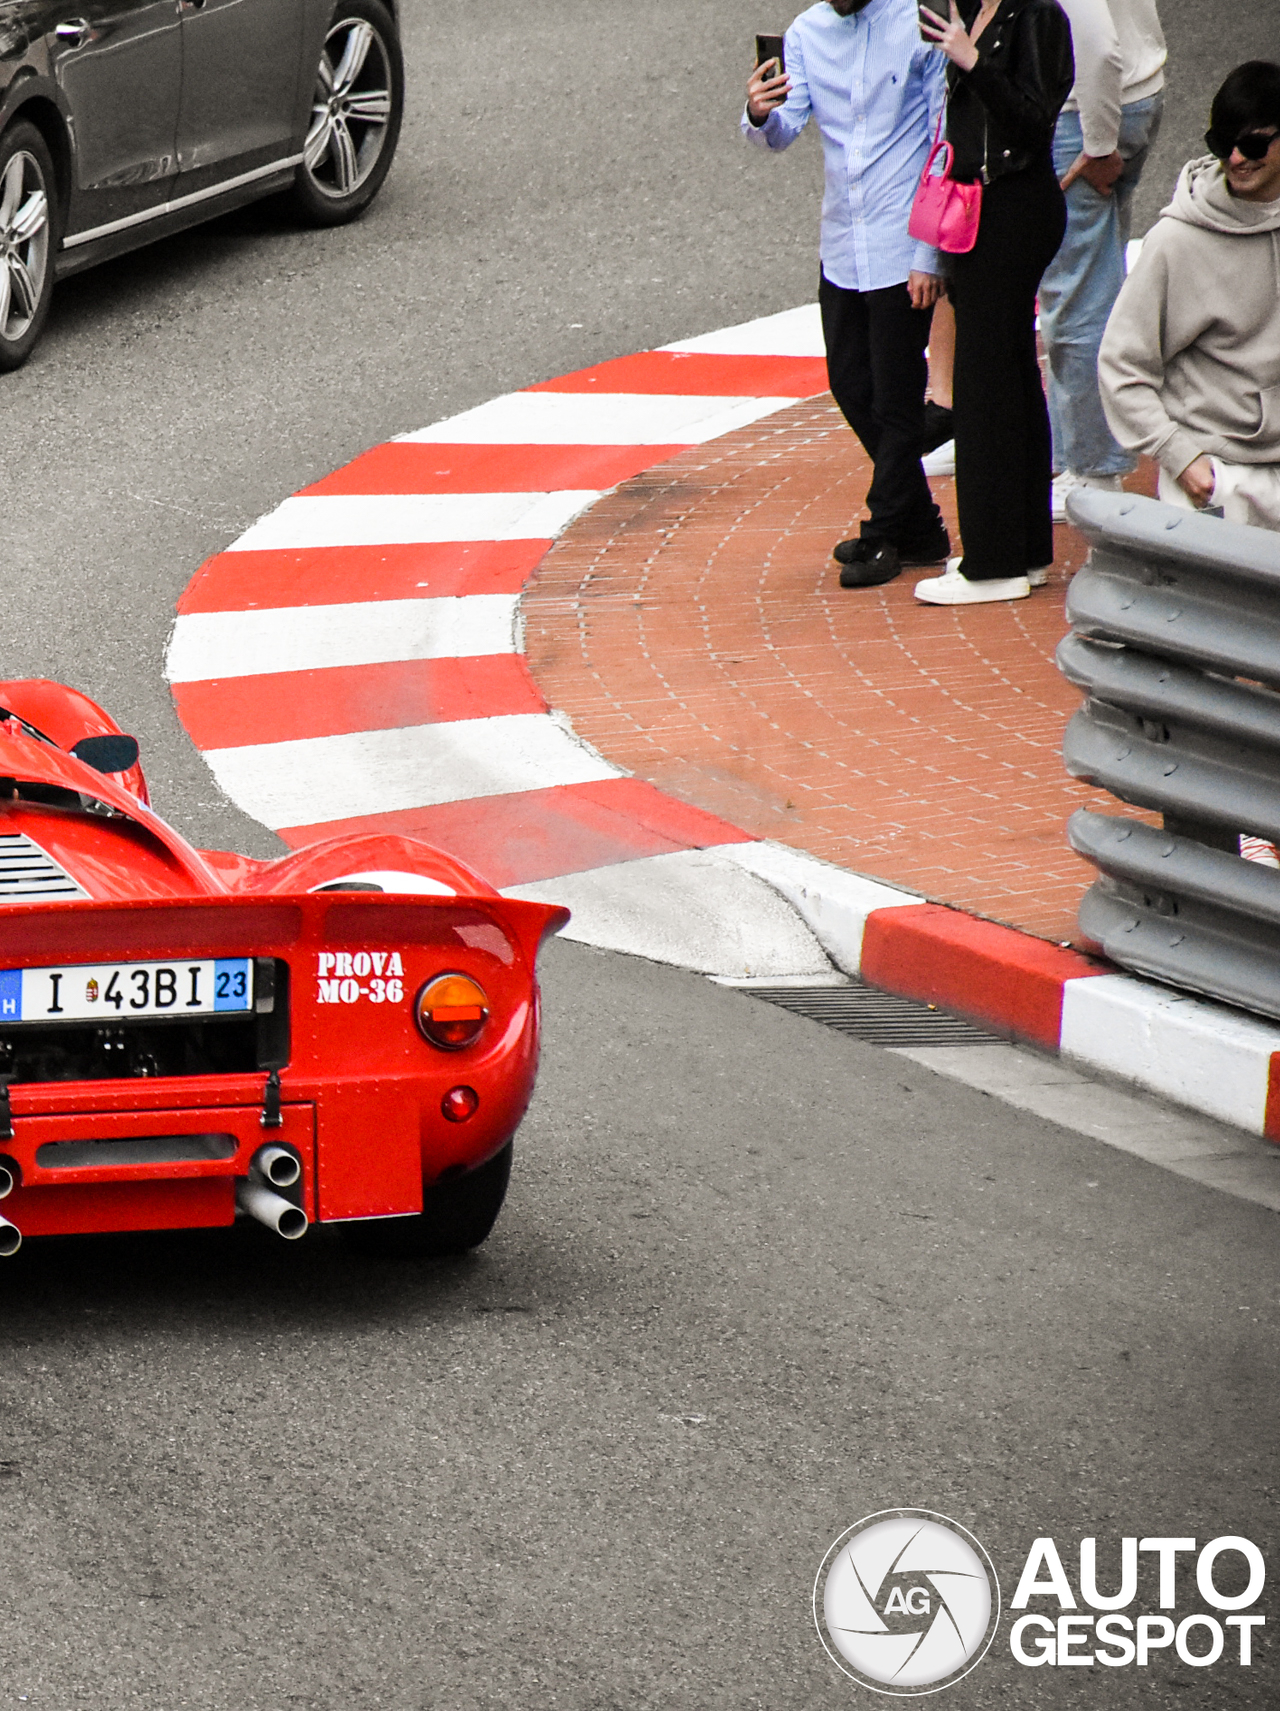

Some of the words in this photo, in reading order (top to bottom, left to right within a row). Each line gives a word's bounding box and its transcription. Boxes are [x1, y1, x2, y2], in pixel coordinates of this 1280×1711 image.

[317, 952, 404, 977] PROVA
[46, 973, 64, 1014] I
[104, 966, 202, 1011] 43BI
[215, 970, 248, 999] 23
[316, 978, 404, 1004] MO-36
[2, 998, 17, 1015] H
